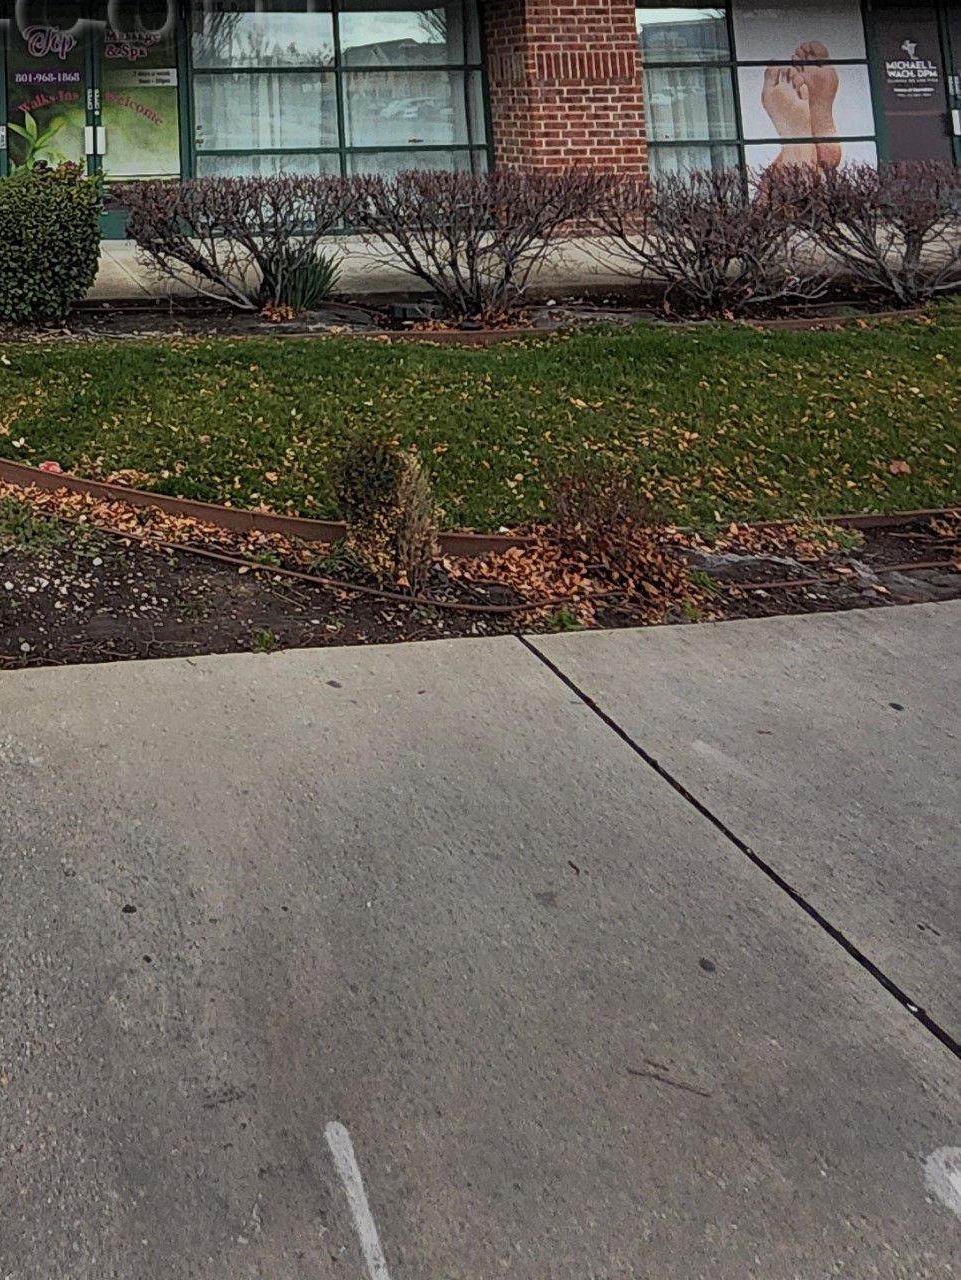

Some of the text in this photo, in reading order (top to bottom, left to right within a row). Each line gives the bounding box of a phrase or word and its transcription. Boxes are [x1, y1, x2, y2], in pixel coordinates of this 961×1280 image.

[21, 25, 78, 61] Top
[885, 61, 927, 70] MICHAEL
[14, 71, 80, 84] 801-968-1868
